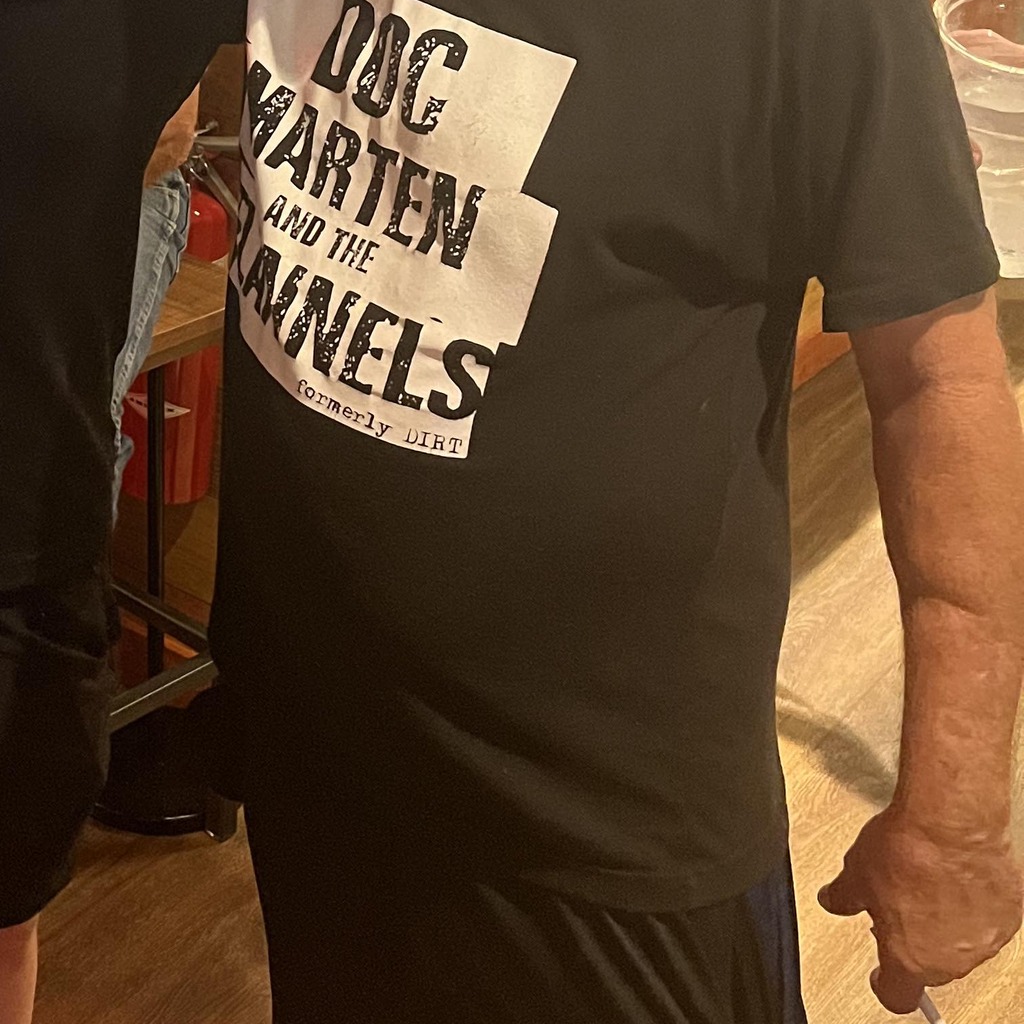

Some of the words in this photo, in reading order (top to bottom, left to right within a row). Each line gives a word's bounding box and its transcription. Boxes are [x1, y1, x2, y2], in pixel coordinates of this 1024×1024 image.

[245, 59, 486, 270] MARTEN
[263, 194, 327, 247] AND
[326, 227, 380, 274] THE
[296, 378, 391, 438] formerly
[403, 427, 464, 456] DIRT
